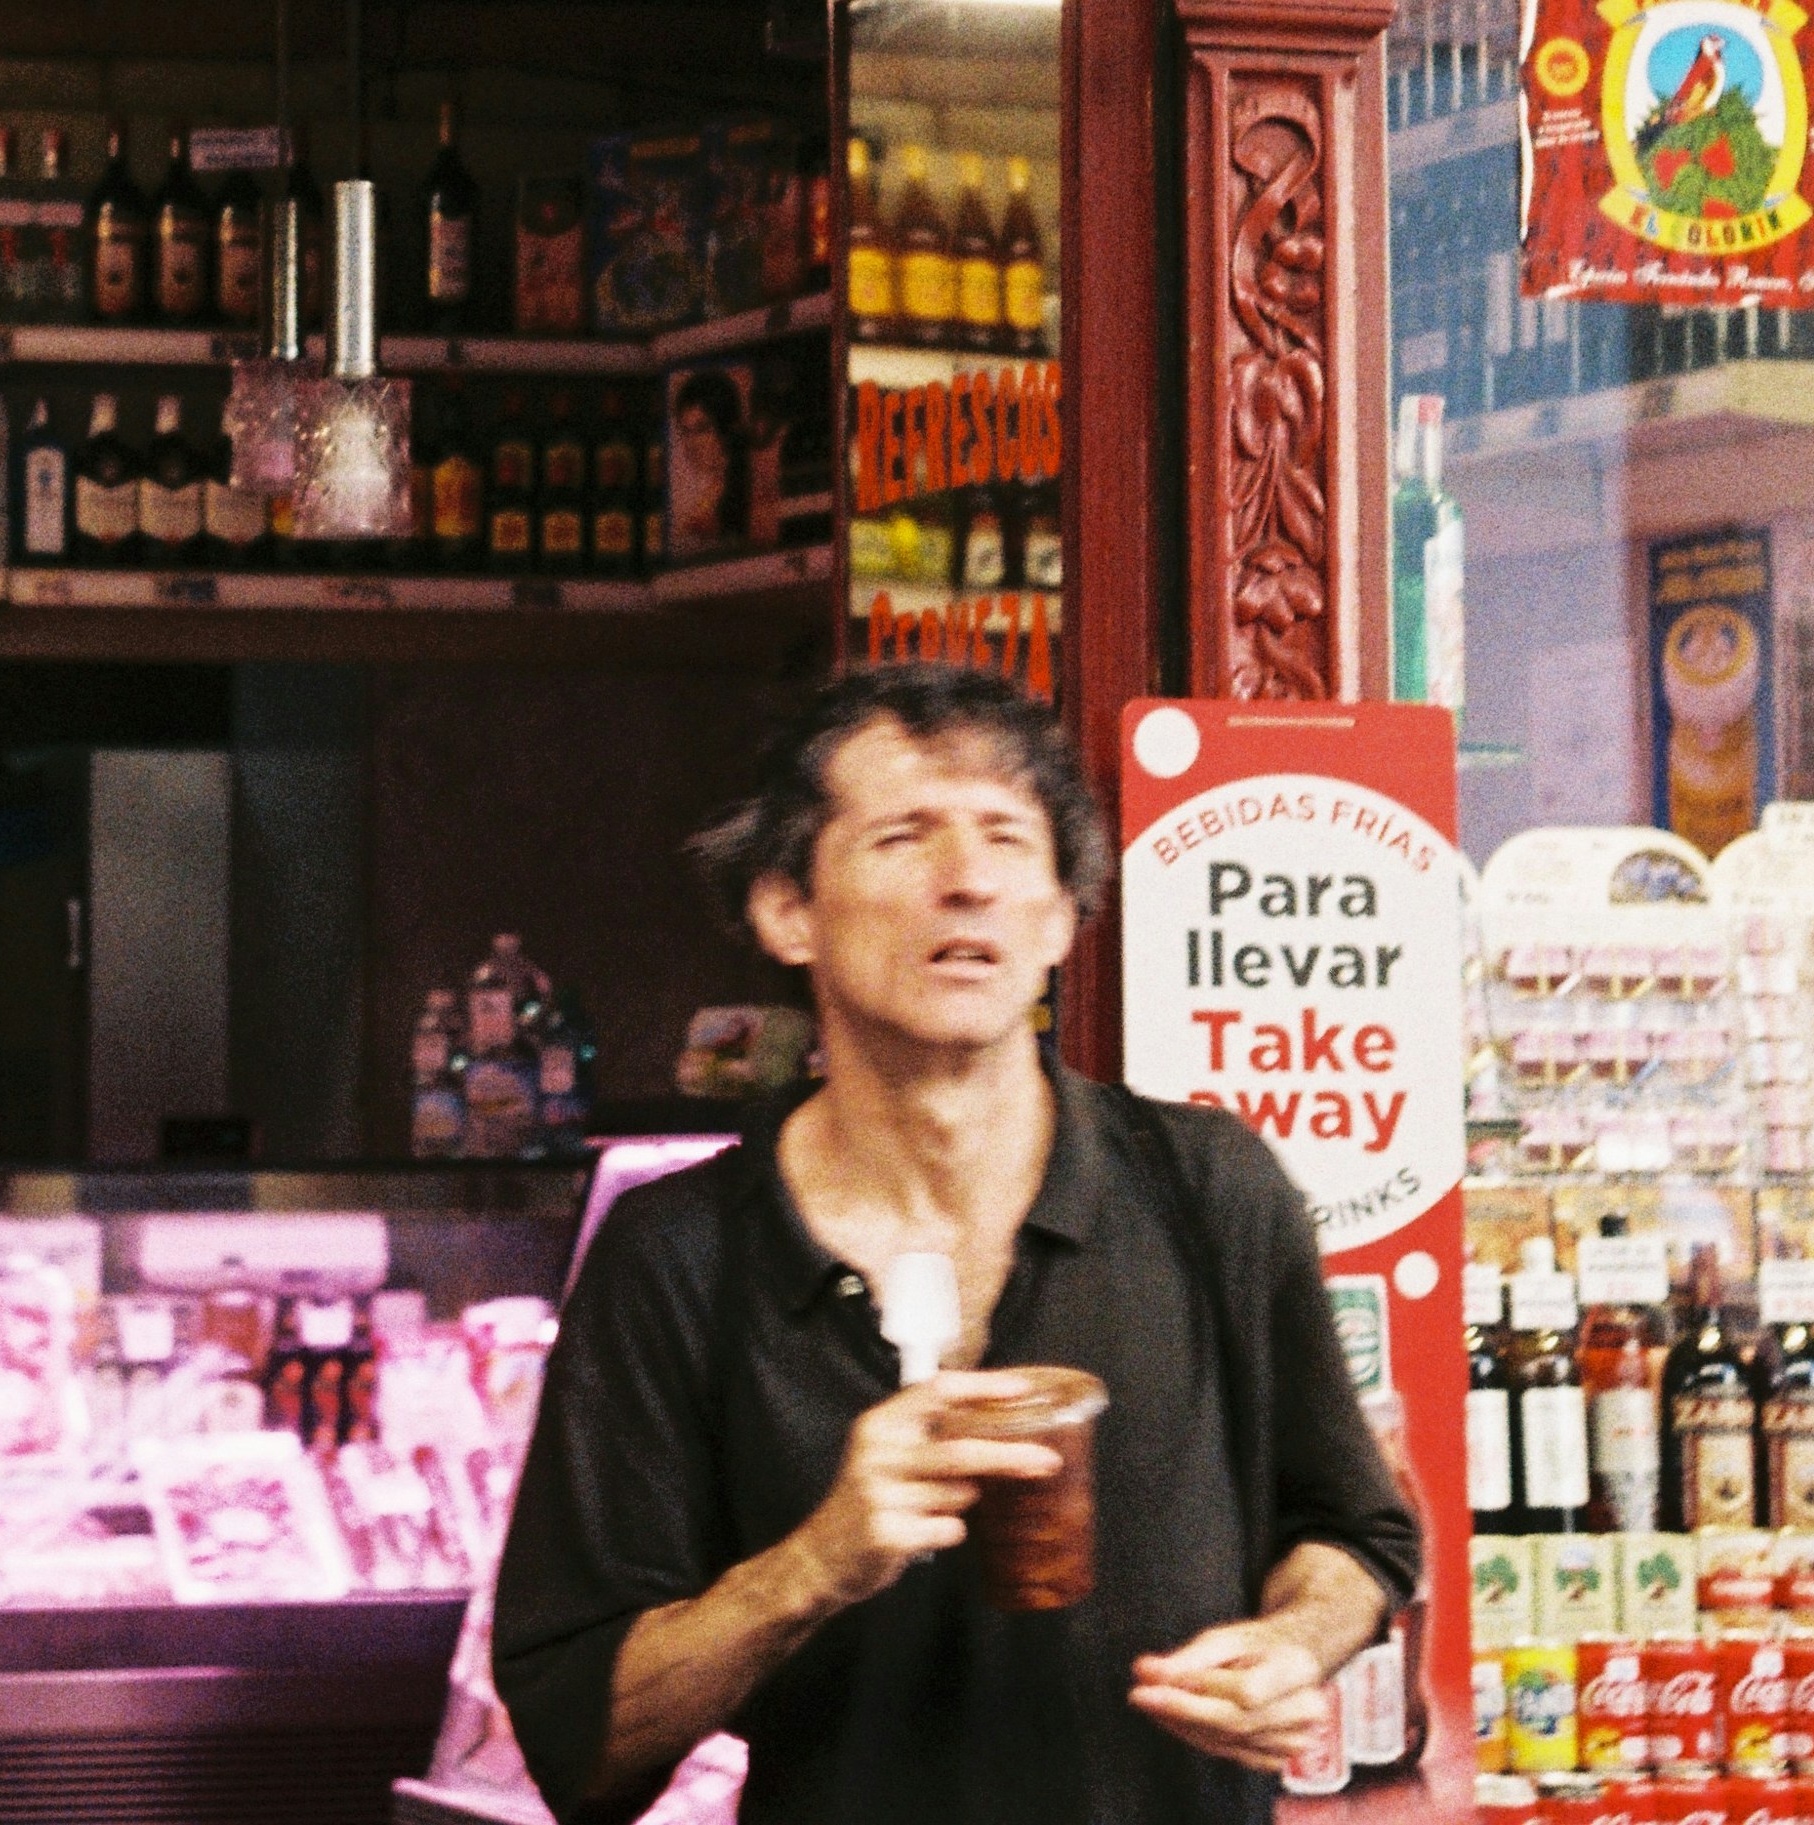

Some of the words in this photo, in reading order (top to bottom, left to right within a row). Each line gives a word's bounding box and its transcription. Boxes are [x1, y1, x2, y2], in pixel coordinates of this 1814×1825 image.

[855, 363, 1062, 513] REFRESCOS
[1152, 792, 1314, 868] BEBIDAS
[1329, 800, 1434, 875] FRÍAS
[1208, 861, 1377, 918] Para
[1186, 928, 1403, 989] llevar
[1190, 1007, 1398, 1074] Take
